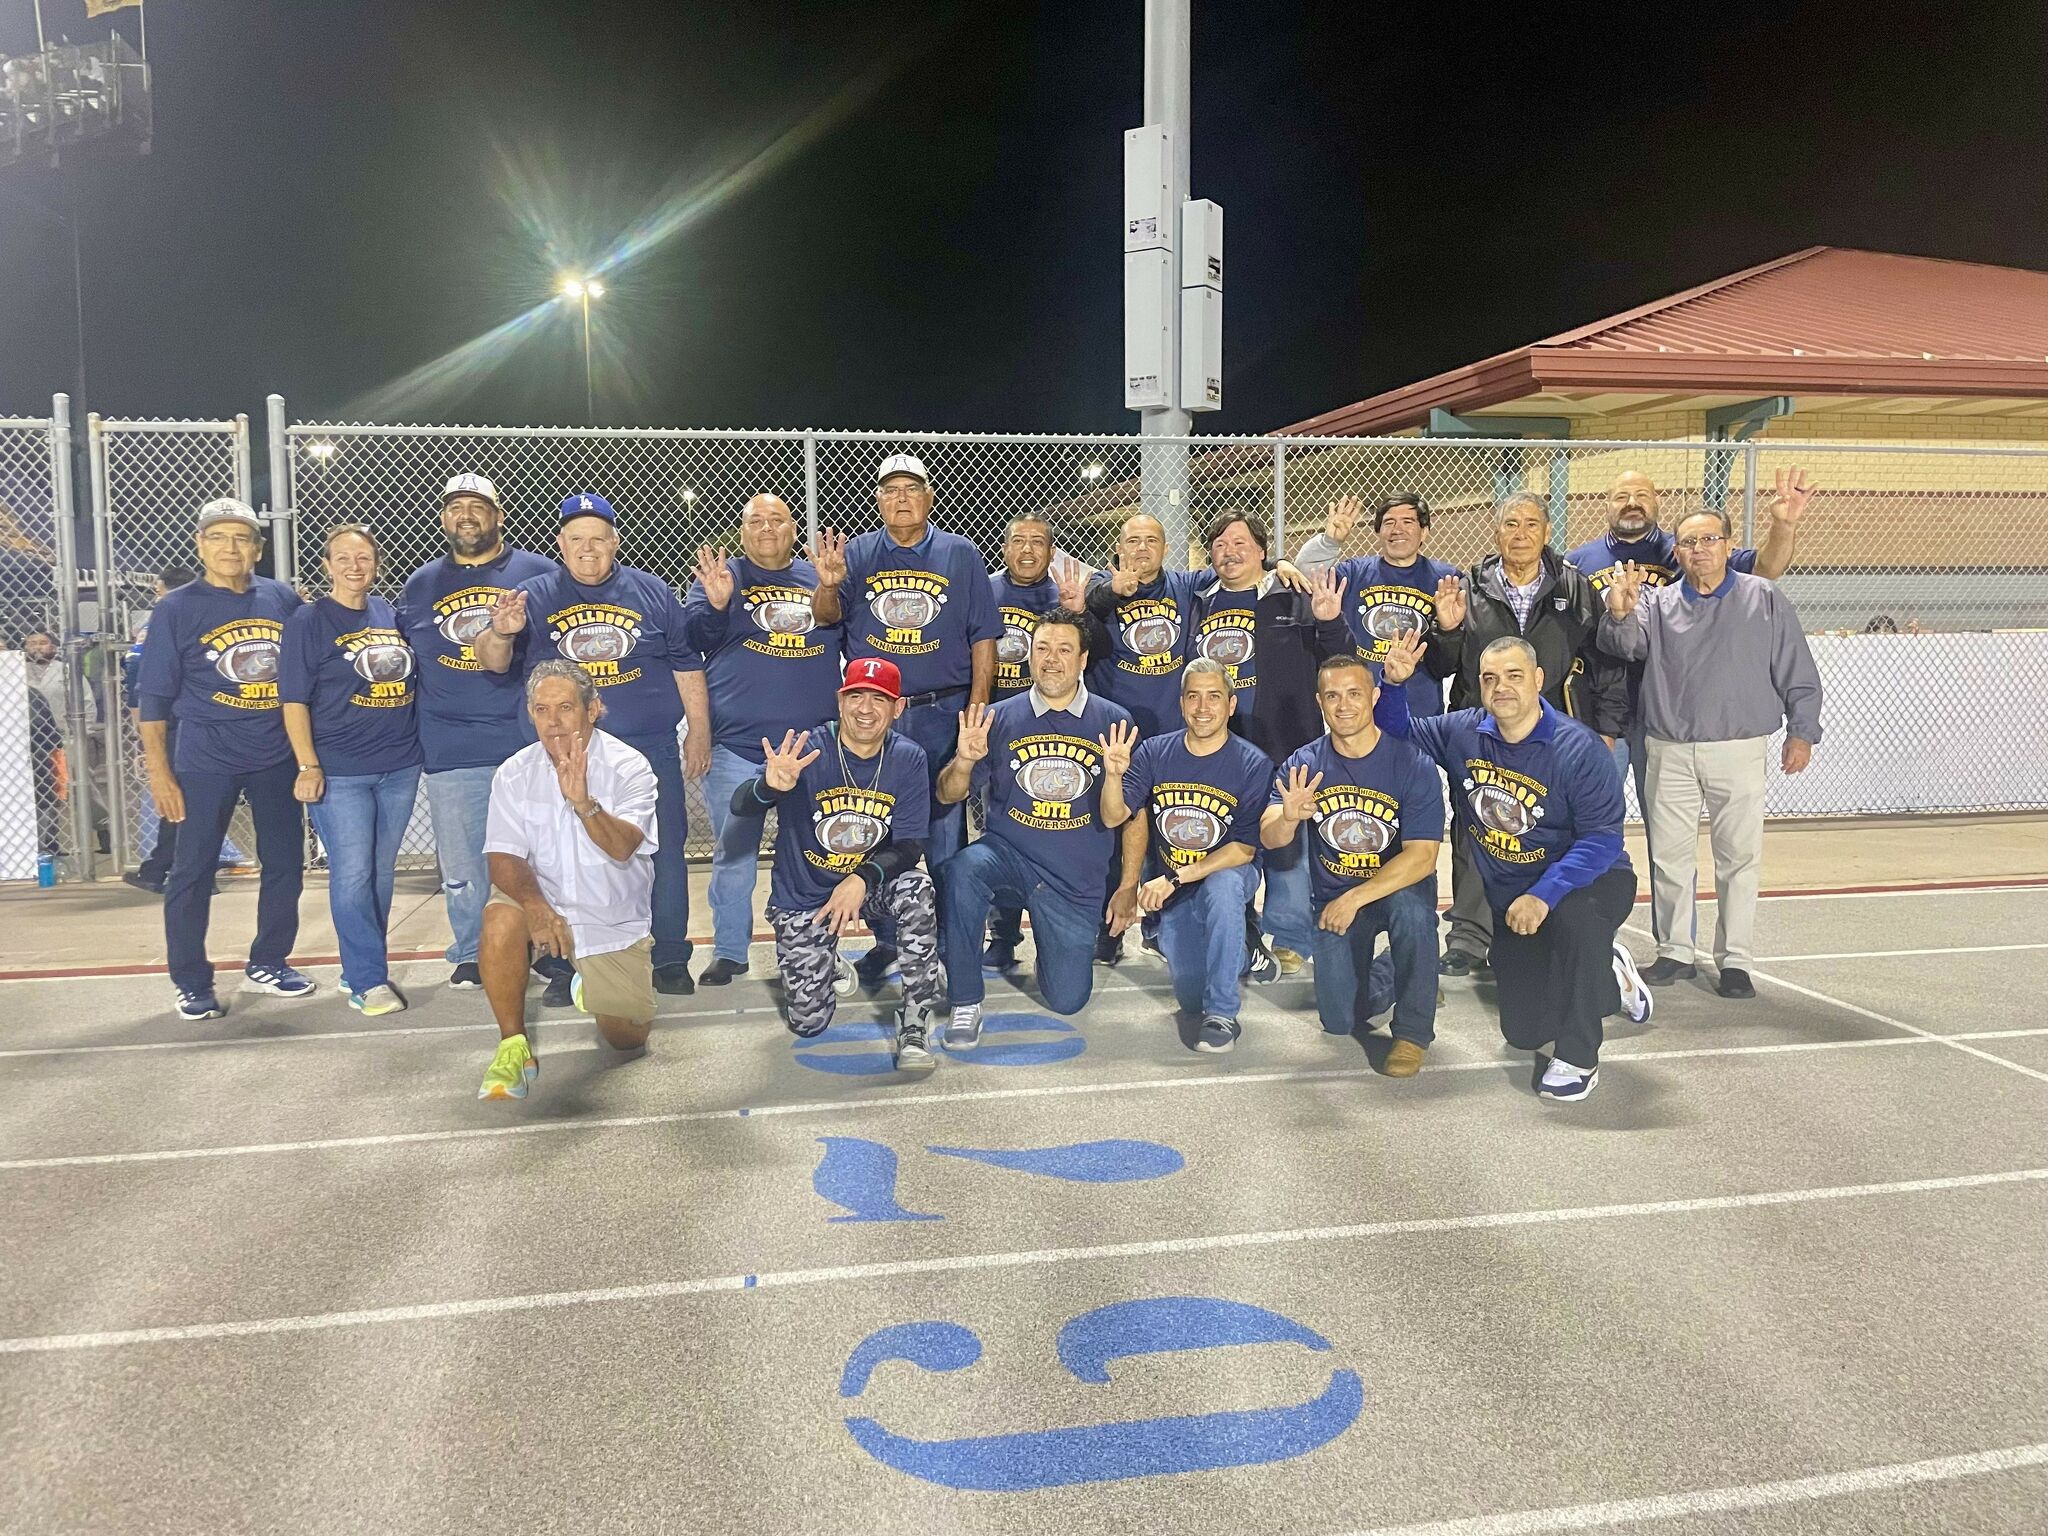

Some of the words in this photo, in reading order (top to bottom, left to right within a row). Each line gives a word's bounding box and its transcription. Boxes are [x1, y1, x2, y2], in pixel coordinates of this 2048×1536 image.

[892, 457, 910, 470] A
[458, 475, 479, 490] A
[580, 495, 593, 510] LA
[440, 593, 498, 616] BULLDO
[749, 591, 811, 605] BULLDOG
[556, 610, 635, 633] BULLDOGS
[1201, 615, 1255, 635] BULLDOG
[768, 632, 806, 648] 30TH
[866, 634, 940, 654] ANNIVERSARY
[885, 628, 922, 644] 30TH
[743, 639, 825, 657] ANNIVERSARY
[1138, 650, 1172, 667] 30TH
[593, 667, 642, 687] ERSARY
[864, 660, 881, 677] T
[239, 682, 279, 699] 30TH
[370, 681, 406, 698] 30TH
[212, 691, 281, 710] ANNIVERS
[1017, 743, 1096, 767] BULLDOGS
[1008, 807, 1091, 830] ANNIVERSARY
[1032, 801, 1072, 819] 30TH
[826, 852, 866, 867] 30TH
[1338, 853, 1381, 868] 30TH
[812, 1136, 1186, 1224] 7
